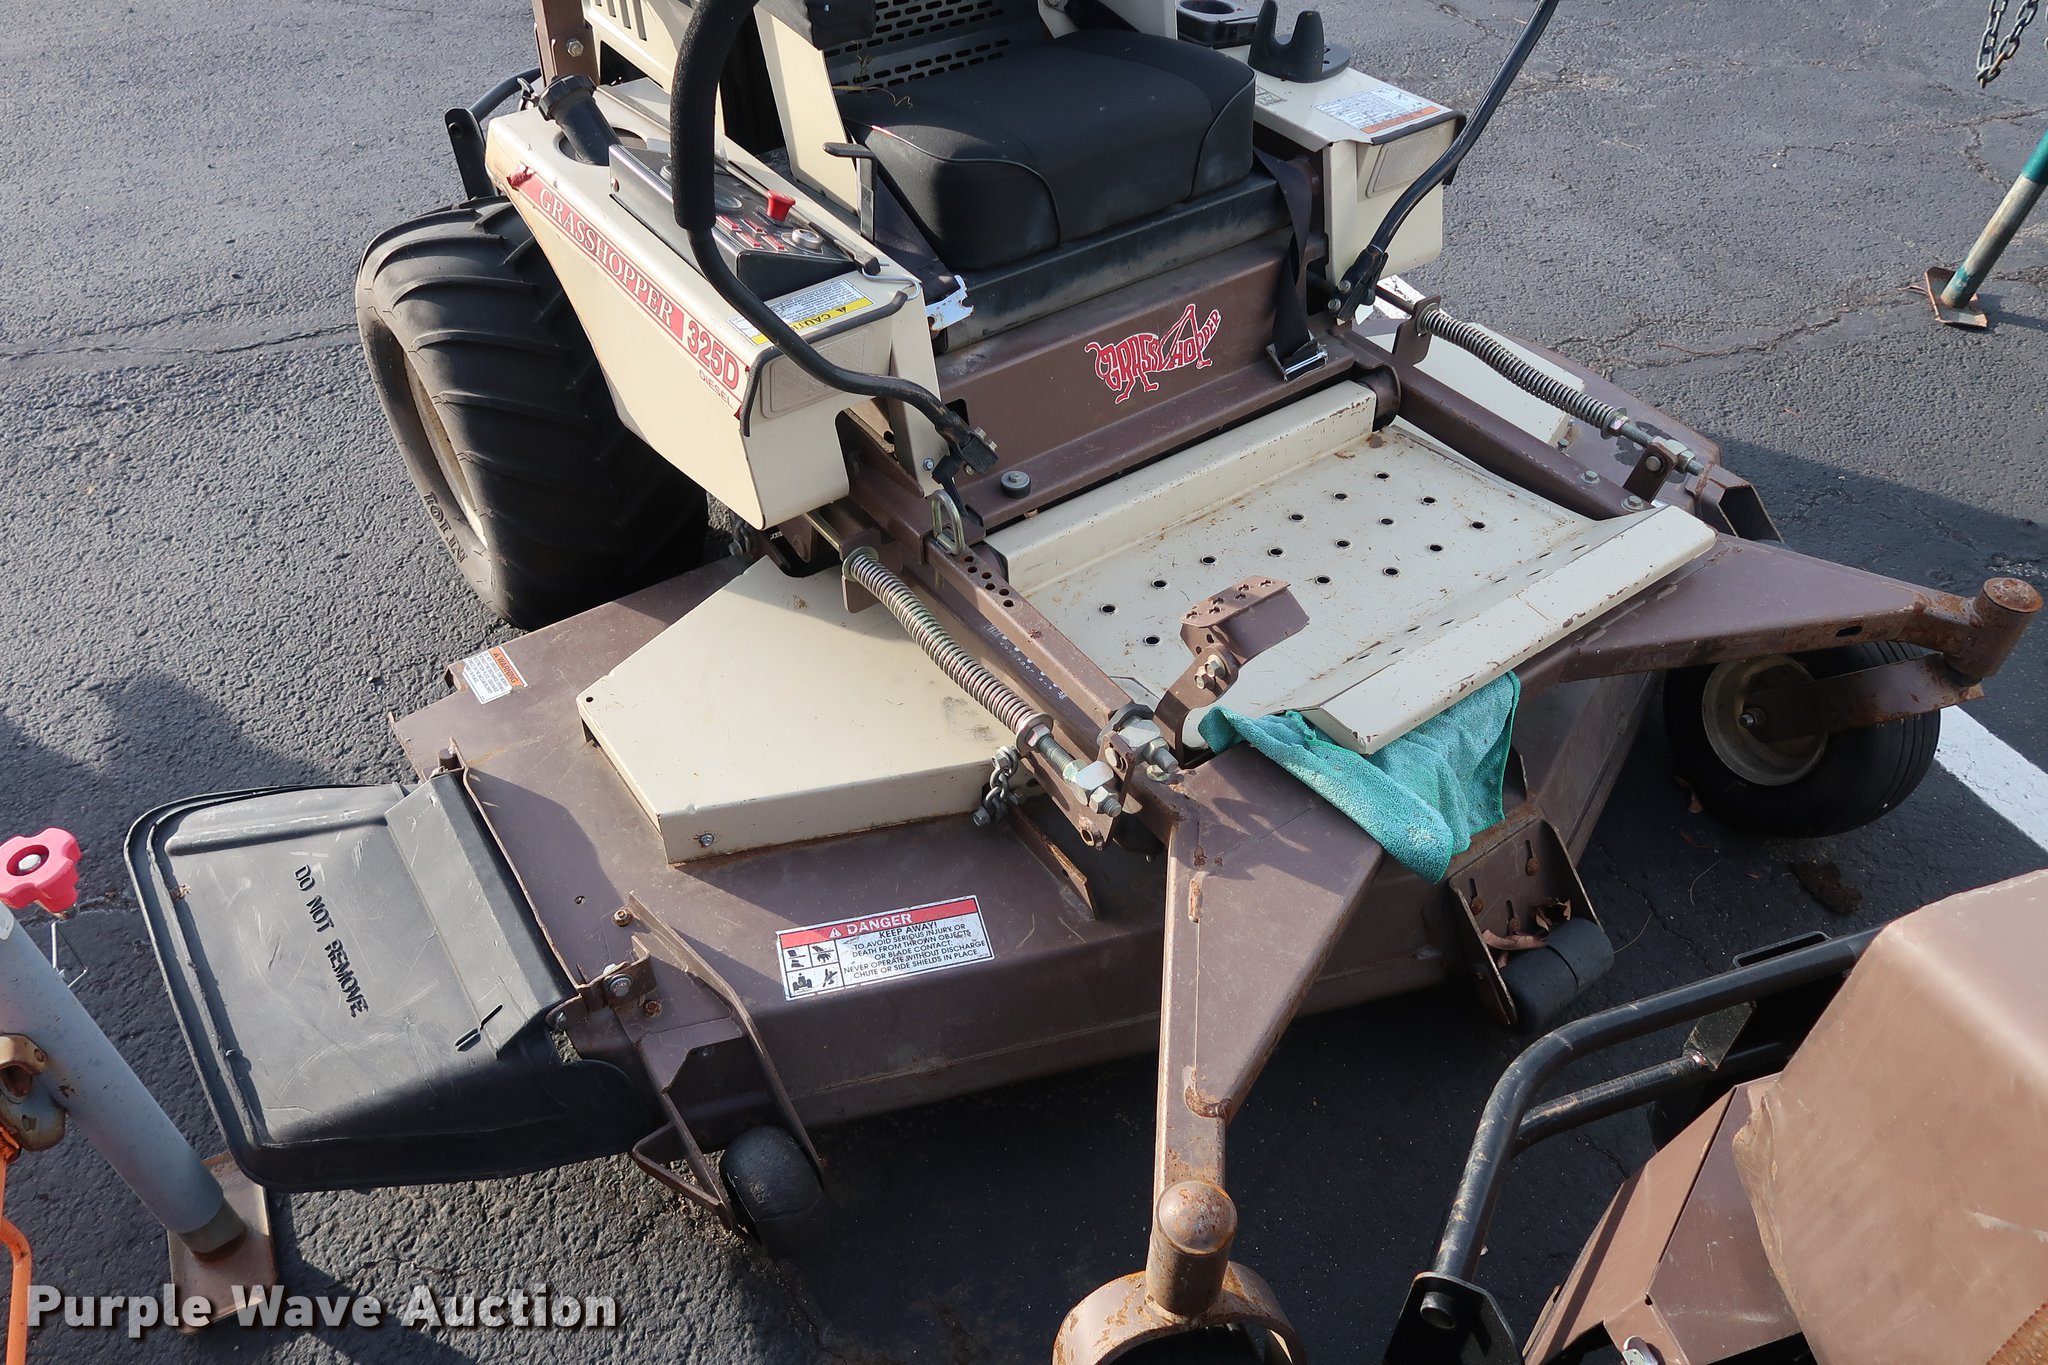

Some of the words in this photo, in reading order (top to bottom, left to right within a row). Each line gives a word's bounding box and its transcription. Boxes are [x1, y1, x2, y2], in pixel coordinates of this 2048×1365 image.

[539, 188, 674, 329] GRASSHOPPER
[687, 319, 740, 391] 325D
[790, 313, 831, 331] CAUTI
[698, 369, 734, 409] DIESEL
[497, 656, 518, 683] WARNING
[847, 913, 912, 935] DANGER
[879, 929, 903, 939] KEEP
[906, 922, 937, 935] AWAY!
[294, 864, 316, 891] DO
[306, 895, 335, 932] NOT
[324, 938, 370, 1018] REMOVE
[853, 948, 877, 957] DEATH
[879, 944, 901, 952] FROM
[903, 938, 937, 947] THROWN
[938, 930, 971, 940] OBJECTS
[867, 939, 892, 948] AVOID
[893, 932, 924, 943] SERIOUS
[888, 948, 912, 957] BLADE
[844, 964, 869, 974] NEVER
[871, 956, 904, 969] OPERATE
[906, 948, 940, 961] WITHOUT
[941, 940, 986, 954] DISCHARGE
[854, 971, 878, 979] CHUTE
[913, 956, 942, 967] SHIELDS
